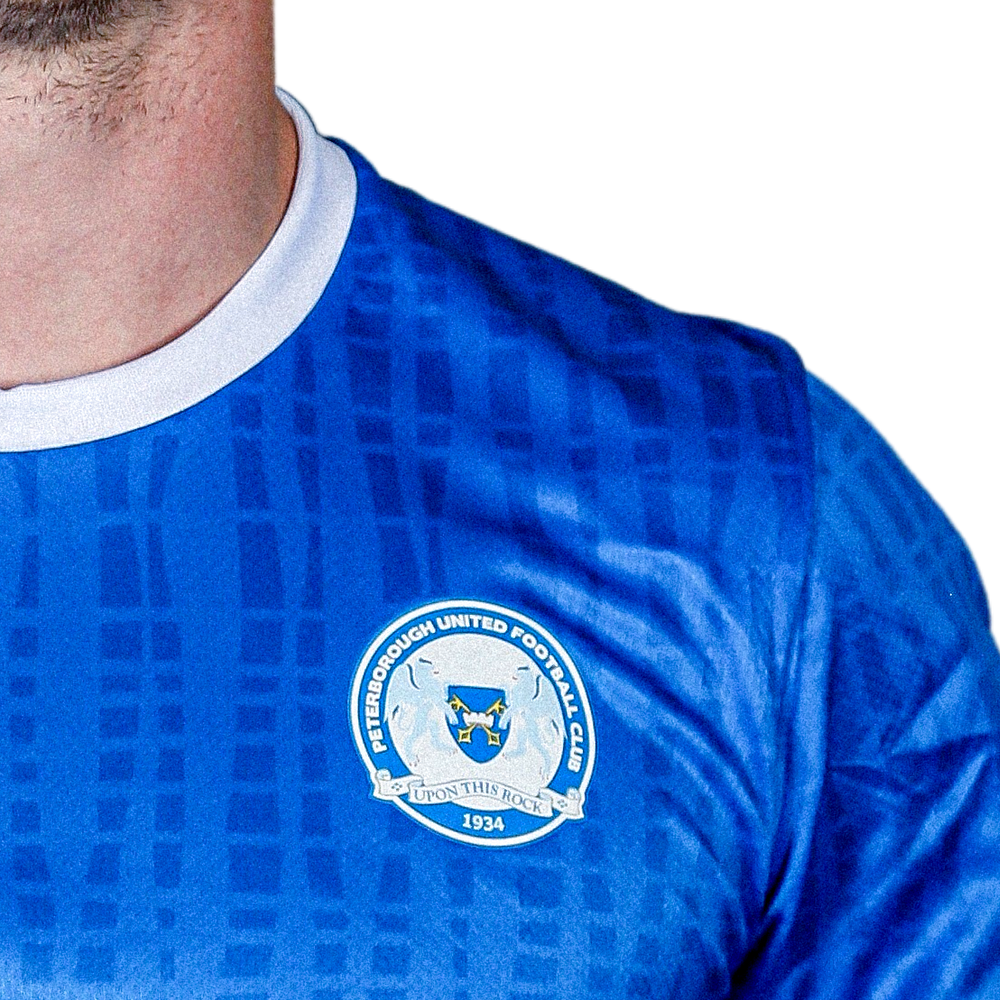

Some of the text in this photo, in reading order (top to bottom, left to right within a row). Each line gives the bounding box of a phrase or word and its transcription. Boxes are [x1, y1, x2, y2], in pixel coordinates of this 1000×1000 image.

[365, 614, 583, 773] PETERBOROUGH UNITED FOOTBALL CLUB
[413, 782, 544, 813] UPON THIS ROCK
[462, 814, 505, 831] 1934
